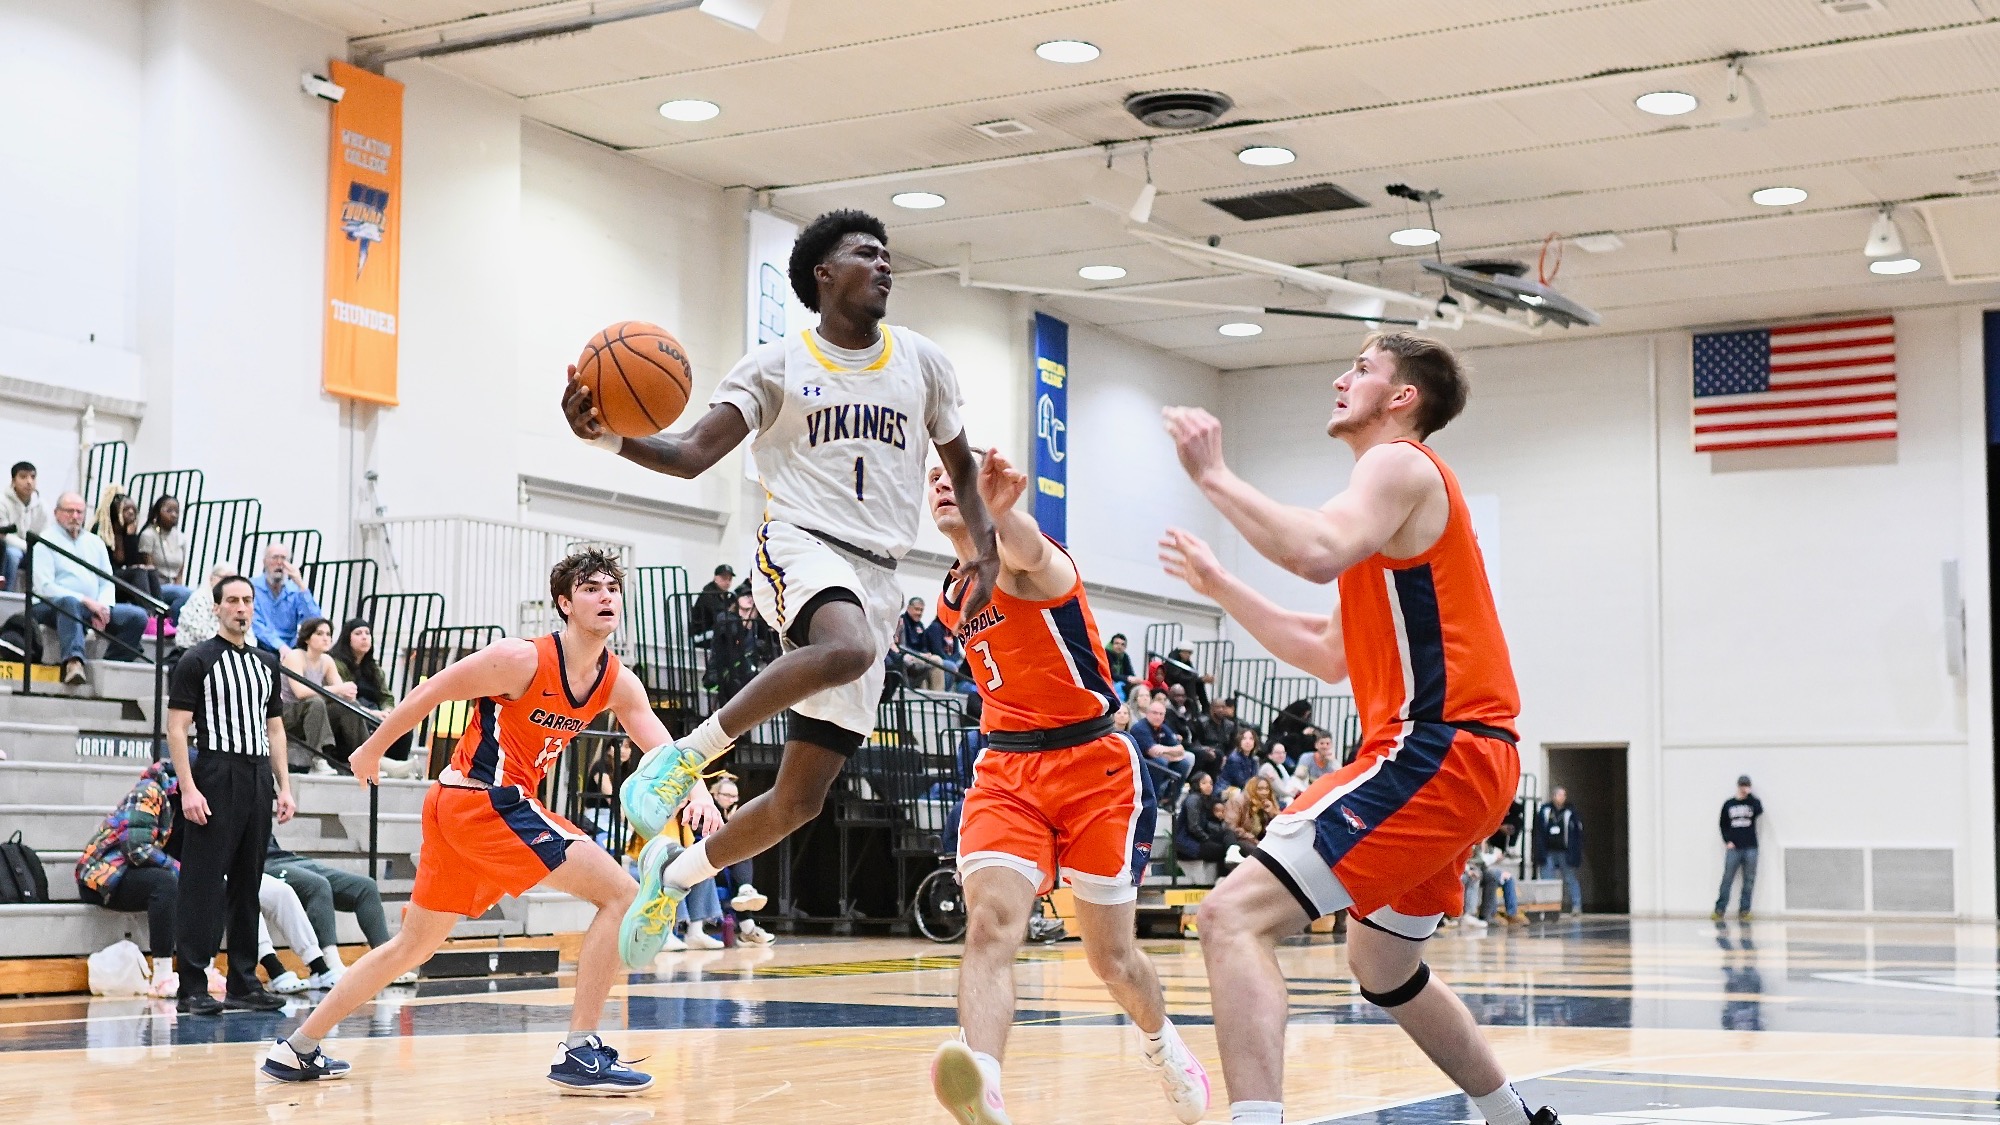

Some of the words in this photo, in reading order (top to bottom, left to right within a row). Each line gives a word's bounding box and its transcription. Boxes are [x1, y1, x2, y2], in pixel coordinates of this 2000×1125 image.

[331, 299, 396, 335] THUNDER
[806, 403, 908, 451] VIKINGS
[854, 456, 864, 501] 1
[957, 604, 1006, 650] ARROLL
[970, 640, 1004, 692] 3
[529, 708, 588, 733] CARROL
[118, 739, 153, 759] PARK
